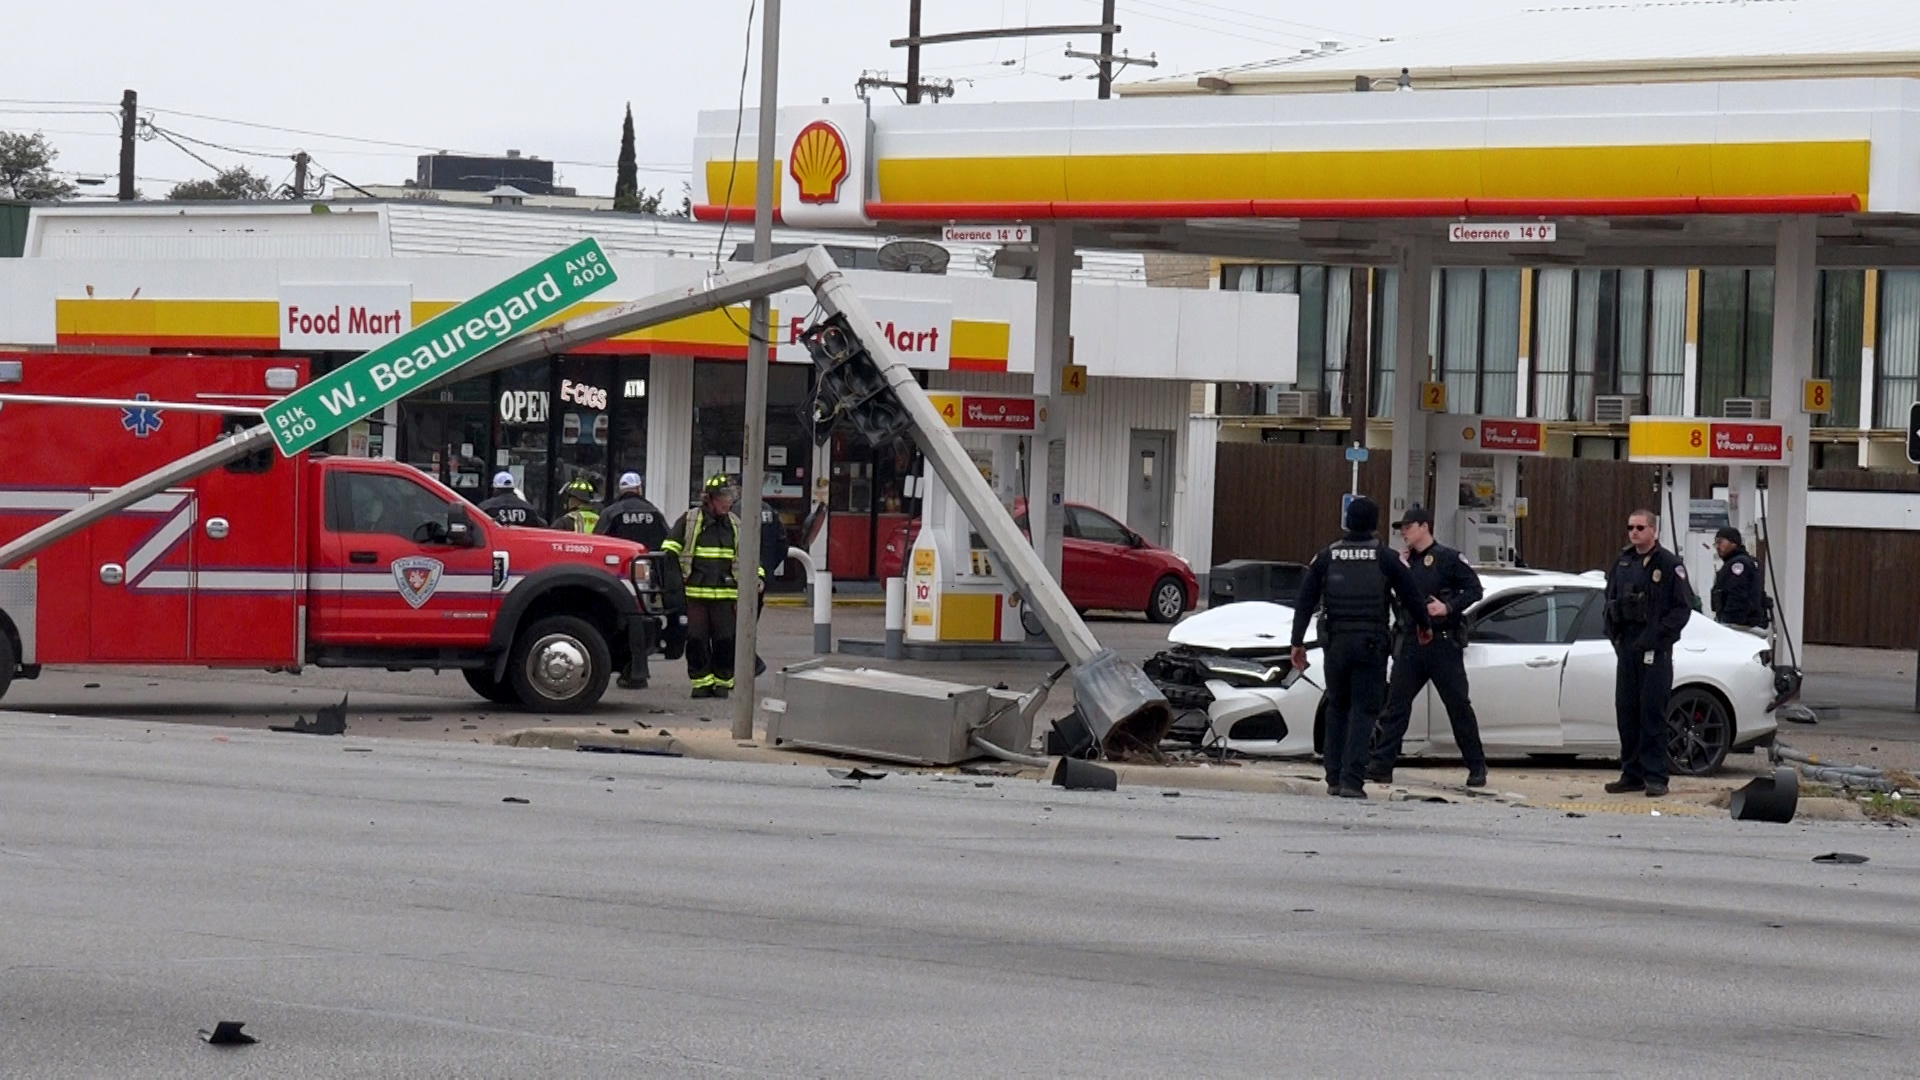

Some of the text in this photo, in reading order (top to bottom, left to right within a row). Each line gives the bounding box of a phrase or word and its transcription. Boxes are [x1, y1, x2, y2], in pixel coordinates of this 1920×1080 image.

[945, 229, 992, 240] Clearance
[1453, 226, 1510, 240] Clearance
[565, 249, 599, 275] Ave
[571, 262, 607, 289] 400
[289, 306, 401, 334] Food Mart
[318, 272, 562, 417] W. Beauregard
[624, 379, 645, 398] ATM
[1069, 371, 1081, 388] 4
[560, 378, 608, 411] E-CIGS
[1430, 387, 1440, 404] 2
[1814, 385, 1824, 406] 8
[500, 389, 550, 423] OPEN
[943, 403, 956, 419] 4
[275, 405, 307, 429] Blk
[281, 416, 317, 445] 300
[1690, 429, 1702, 448] 8
[1331, 548, 1377, 561] POLICE
